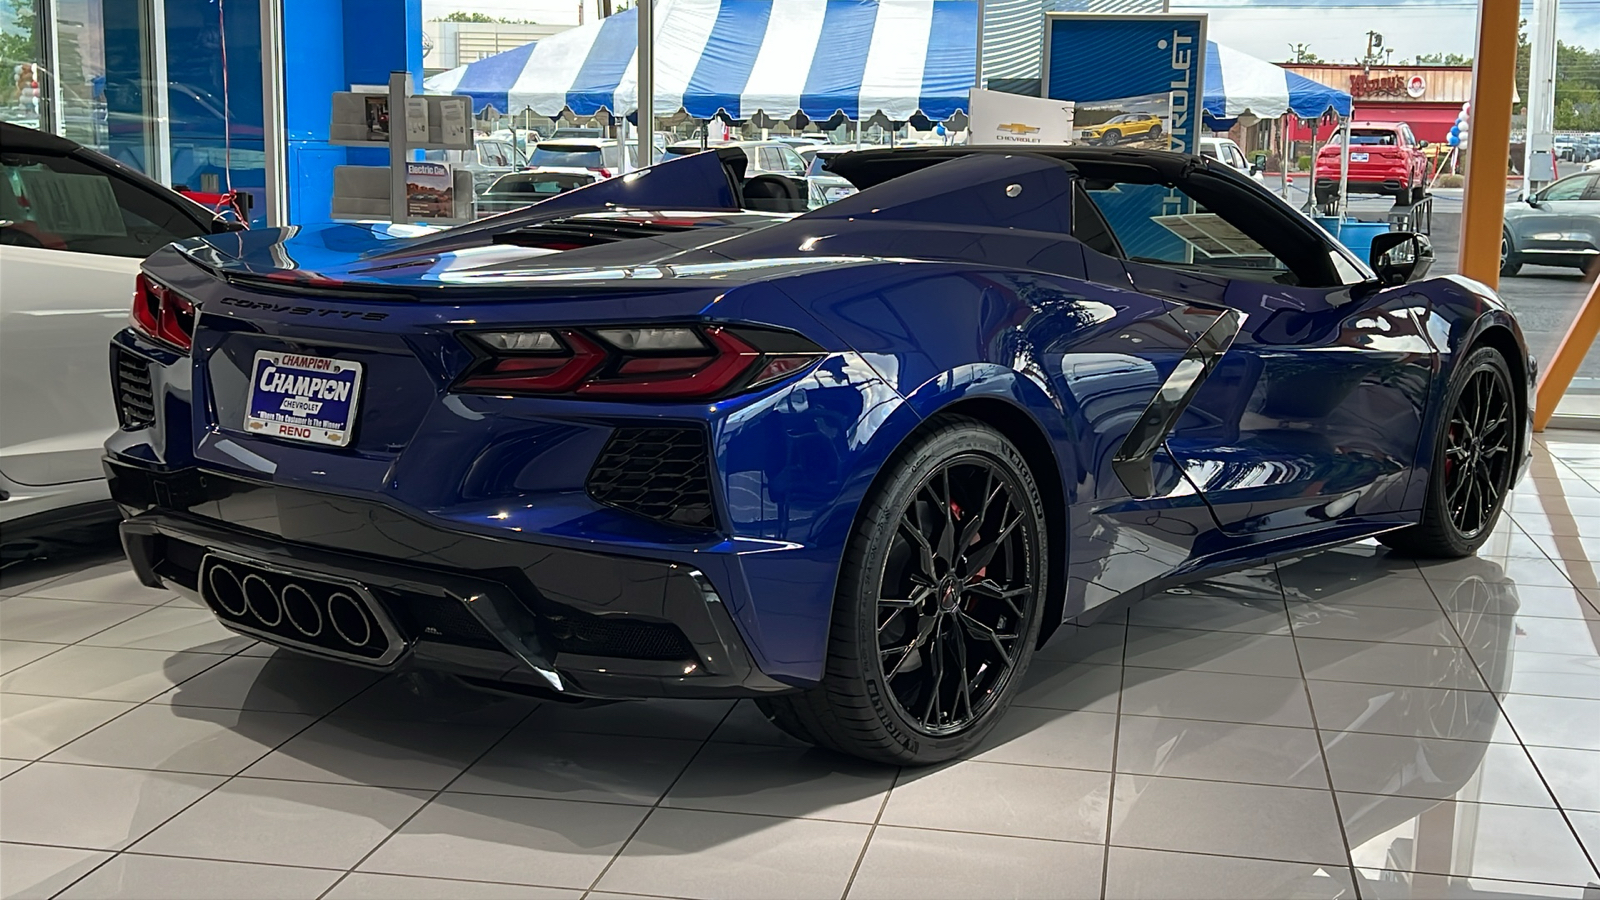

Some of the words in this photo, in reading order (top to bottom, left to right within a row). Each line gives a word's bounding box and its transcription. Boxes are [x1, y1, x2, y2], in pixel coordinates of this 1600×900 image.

[996, 135, 1041, 143] CHEVROLET
[408, 165, 434, 174] Electric
[220, 297, 390, 322] CORVETTE
[281, 355, 332, 370] CHAMPION
[259, 366, 351, 402] CHAMPION
[283, 400, 319, 412] CHEVROLET
[275, 412, 284, 421] The
[313, 418, 322, 427] The
[278, 425, 312, 439] RENO
[1010, 453, 1044, 516] MICHELIN
[867, 680, 908, 746] MICHELIN
